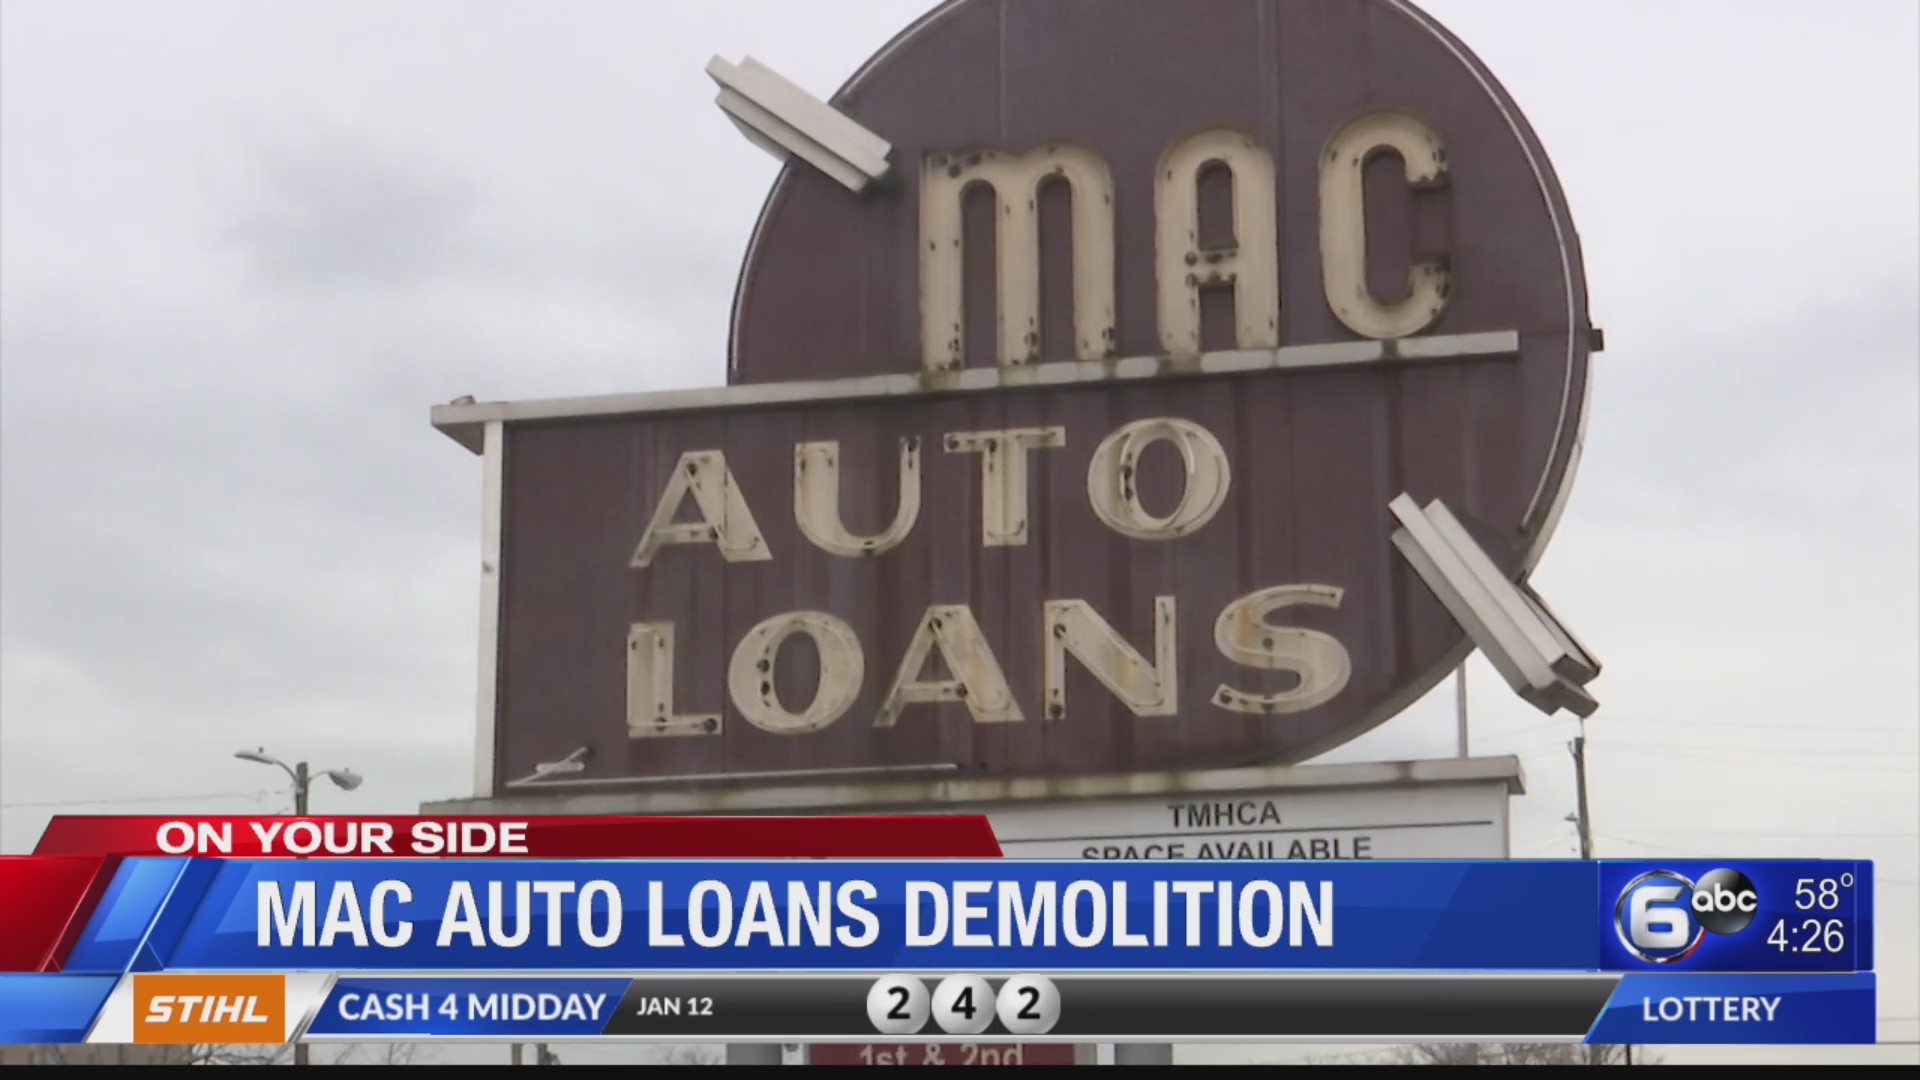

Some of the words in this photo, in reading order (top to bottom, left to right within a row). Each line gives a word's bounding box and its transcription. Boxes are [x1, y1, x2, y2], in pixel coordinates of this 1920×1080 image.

[921, 111, 1450, 371] MAC
[629, 417, 1231, 568] AUTO
[626, 584, 1352, 738] LOANS
[1168, 801, 1281, 828] TMHCA
[1197, 836, 1372, 859] AVAILABLE
